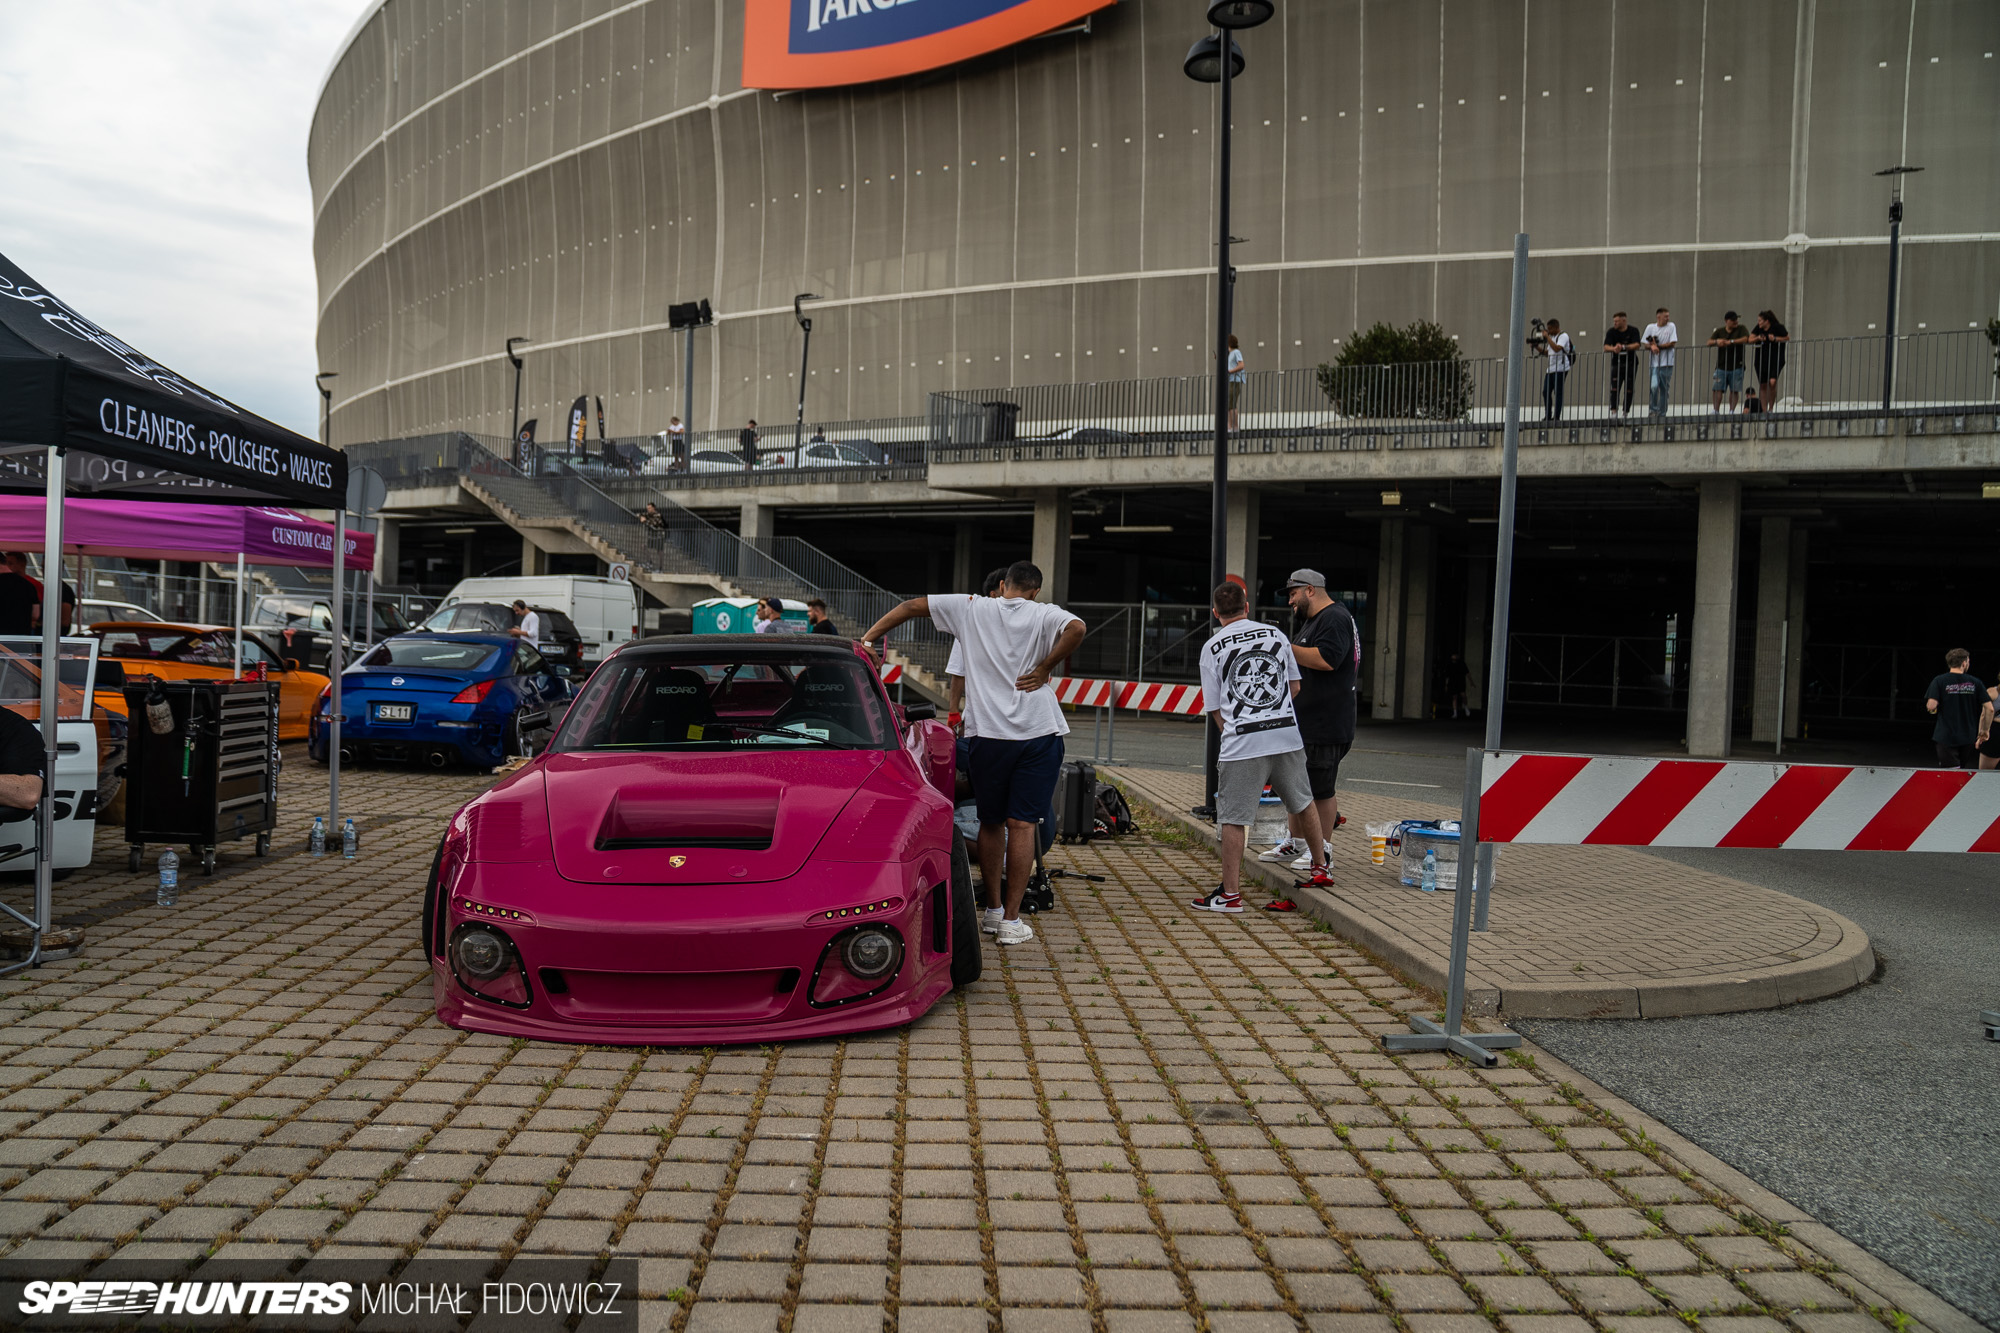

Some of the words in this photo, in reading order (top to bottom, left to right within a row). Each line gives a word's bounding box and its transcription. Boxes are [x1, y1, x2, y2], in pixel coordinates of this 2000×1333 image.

[100, 398, 197, 455] CLEANERS
[209, 430, 280, 476] POLISHES
[290, 452, 332, 489] WAXES
[272, 526, 314, 548] CUSTOM
[314, 533, 333, 551] CAR
[655, 686, 698, 695] RECARO
[804, 683, 845, 692] RECARO
